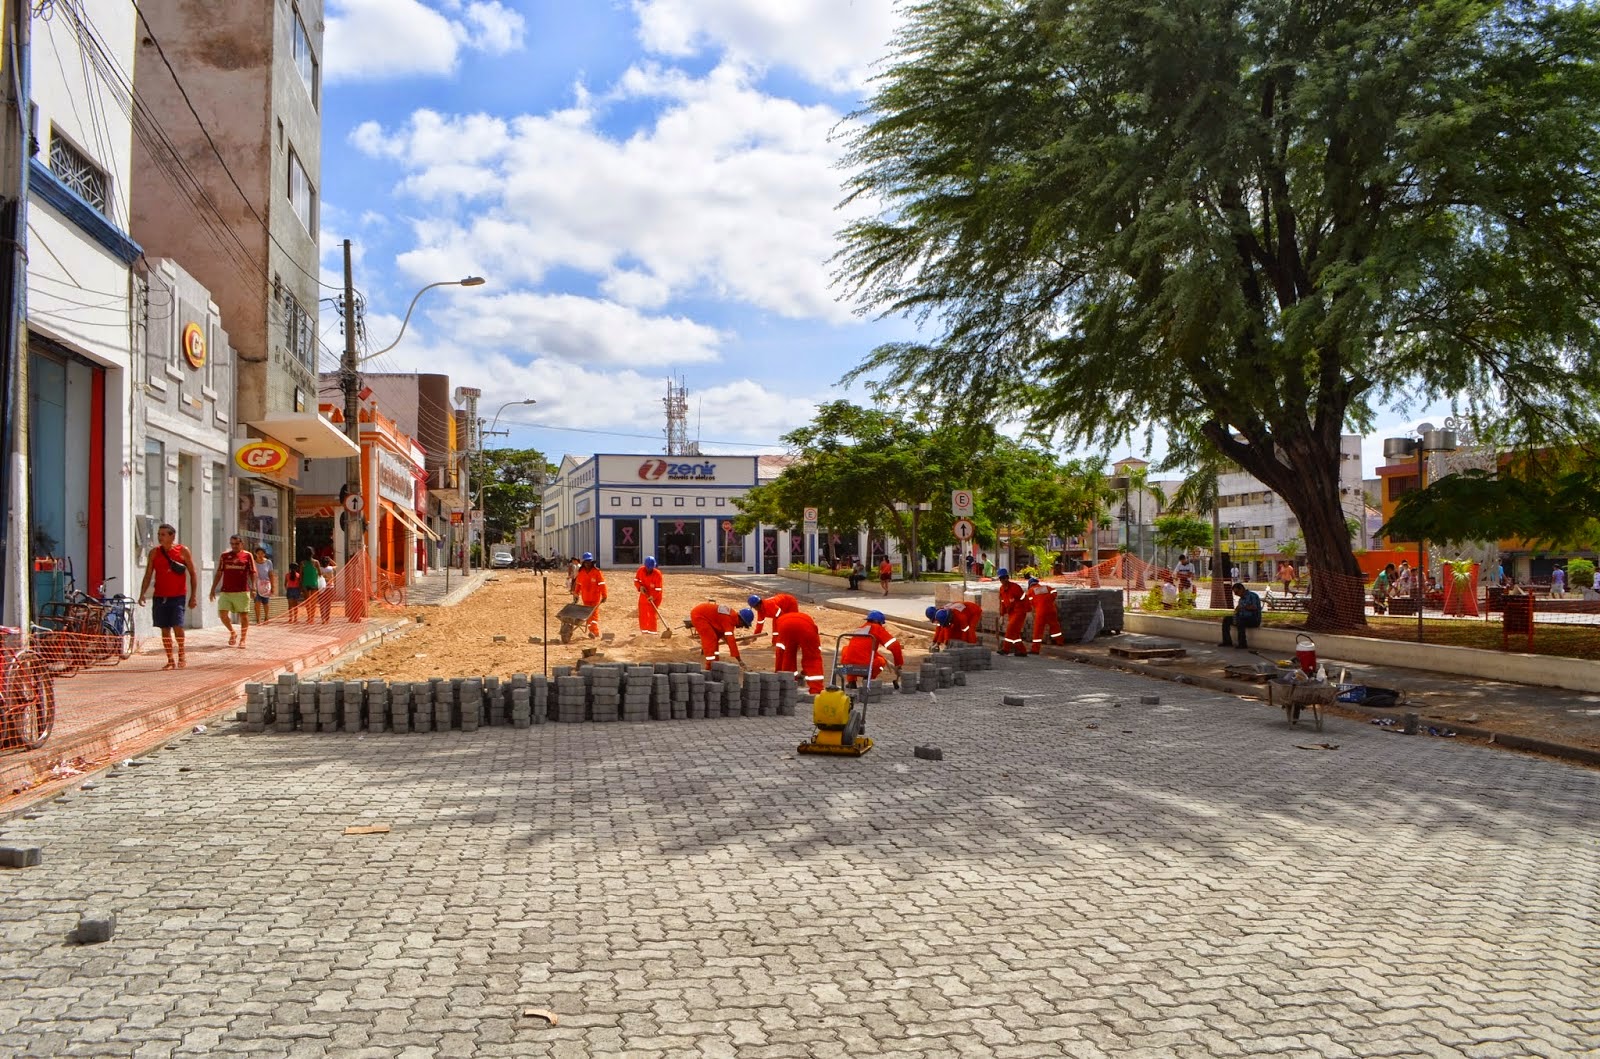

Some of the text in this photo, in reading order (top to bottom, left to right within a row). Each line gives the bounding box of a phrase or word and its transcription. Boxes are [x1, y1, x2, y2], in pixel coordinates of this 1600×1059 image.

[247, 449, 276, 466] GF
[667, 461, 716, 475] zenir
[959, 495, 965, 504] E
